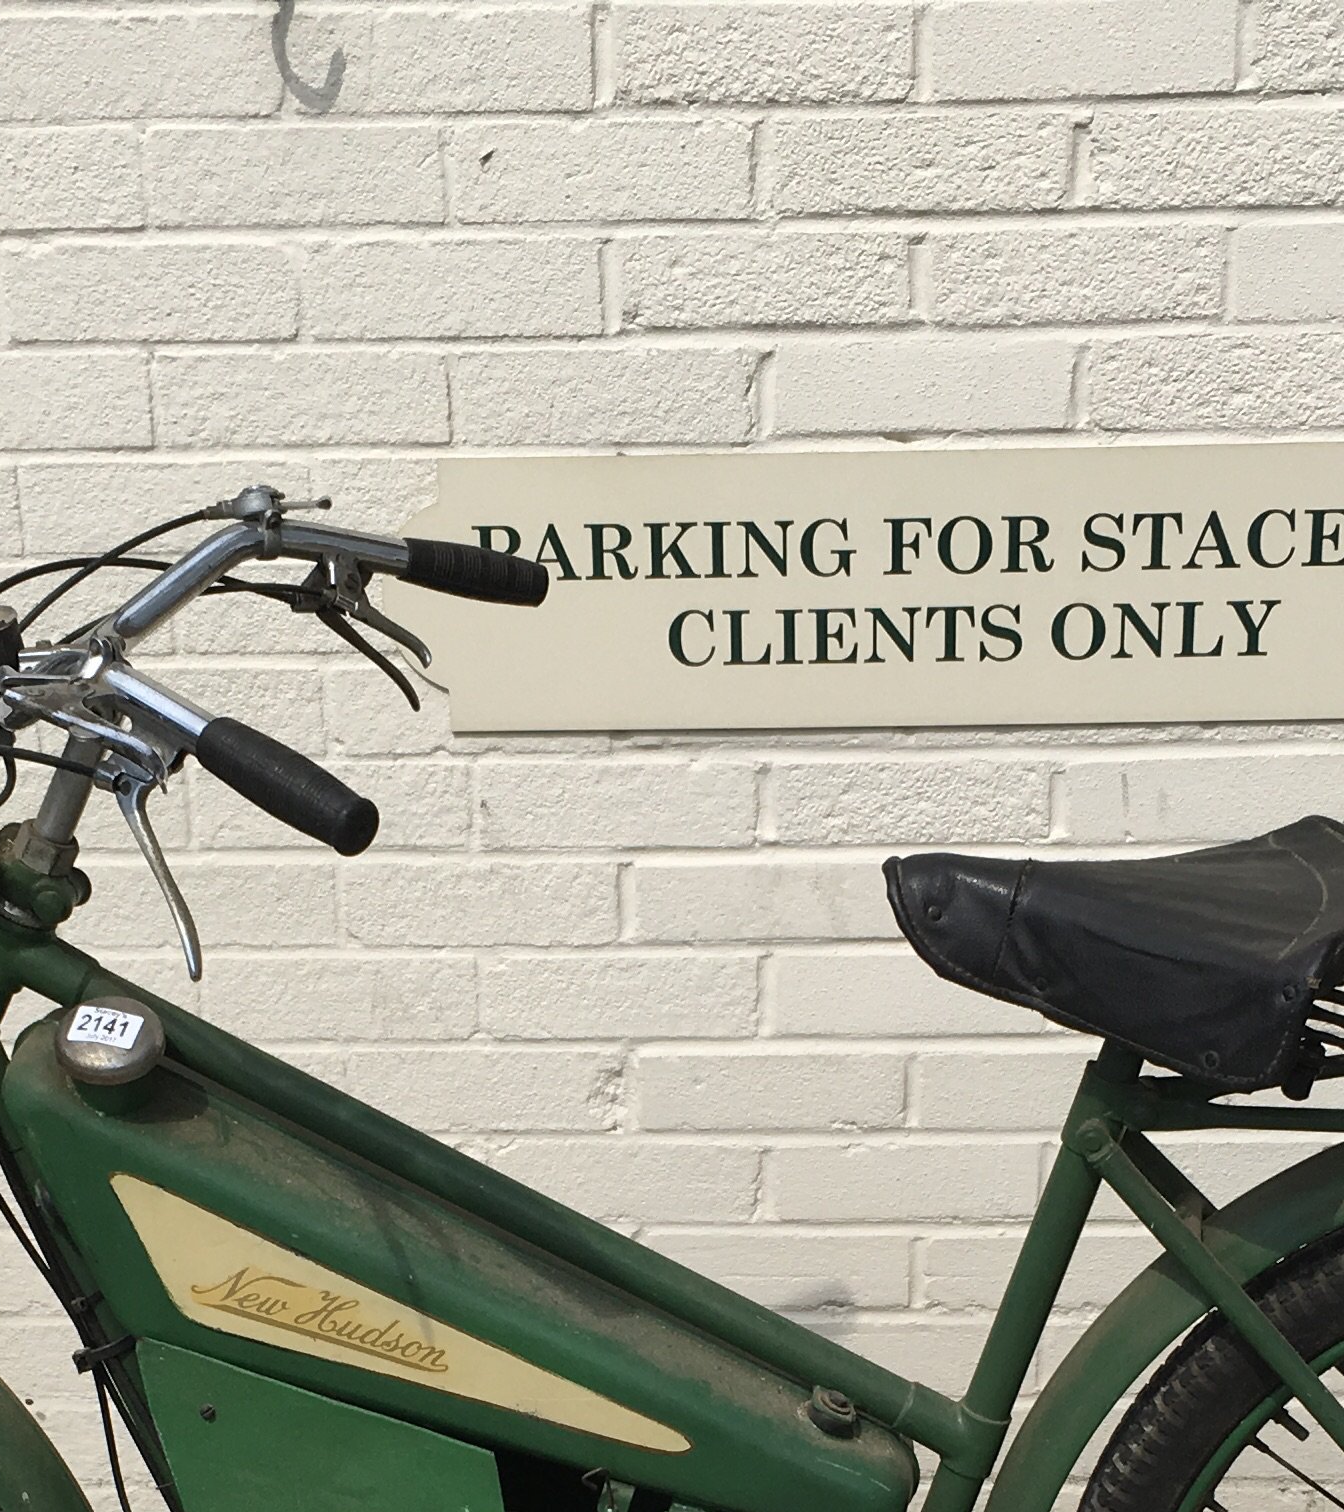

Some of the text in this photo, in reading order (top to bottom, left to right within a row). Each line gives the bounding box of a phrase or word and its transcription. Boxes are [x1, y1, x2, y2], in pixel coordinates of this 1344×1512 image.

[470, 517, 858, 582] PARKING
[883, 515, 1055, 576] FOR
[667, 600, 1282, 668] CLIENTS ONLY
[77, 1014, 129, 1037] 2141
[191, 1267, 449, 1373] New Hudson
